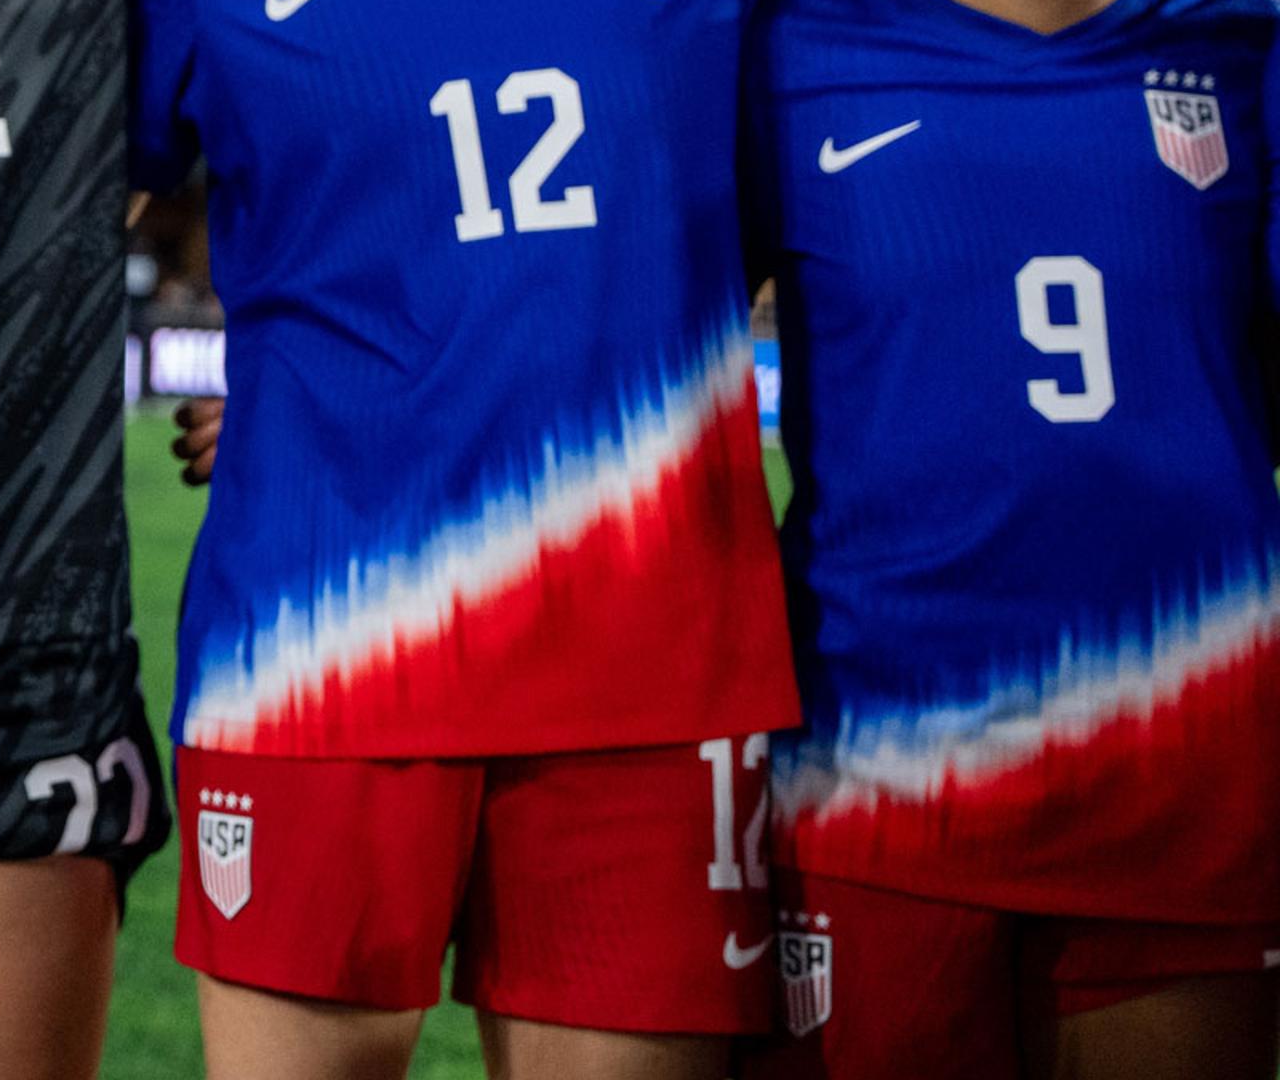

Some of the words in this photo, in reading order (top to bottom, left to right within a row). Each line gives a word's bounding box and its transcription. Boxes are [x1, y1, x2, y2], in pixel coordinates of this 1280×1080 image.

[1152, 98, 1214, 134] USA
[429, 67, 598, 243] 12
[1014, 255, 1116, 424] 9
[200, 820, 246, 858] USA
[782, 938, 825, 976] SA
